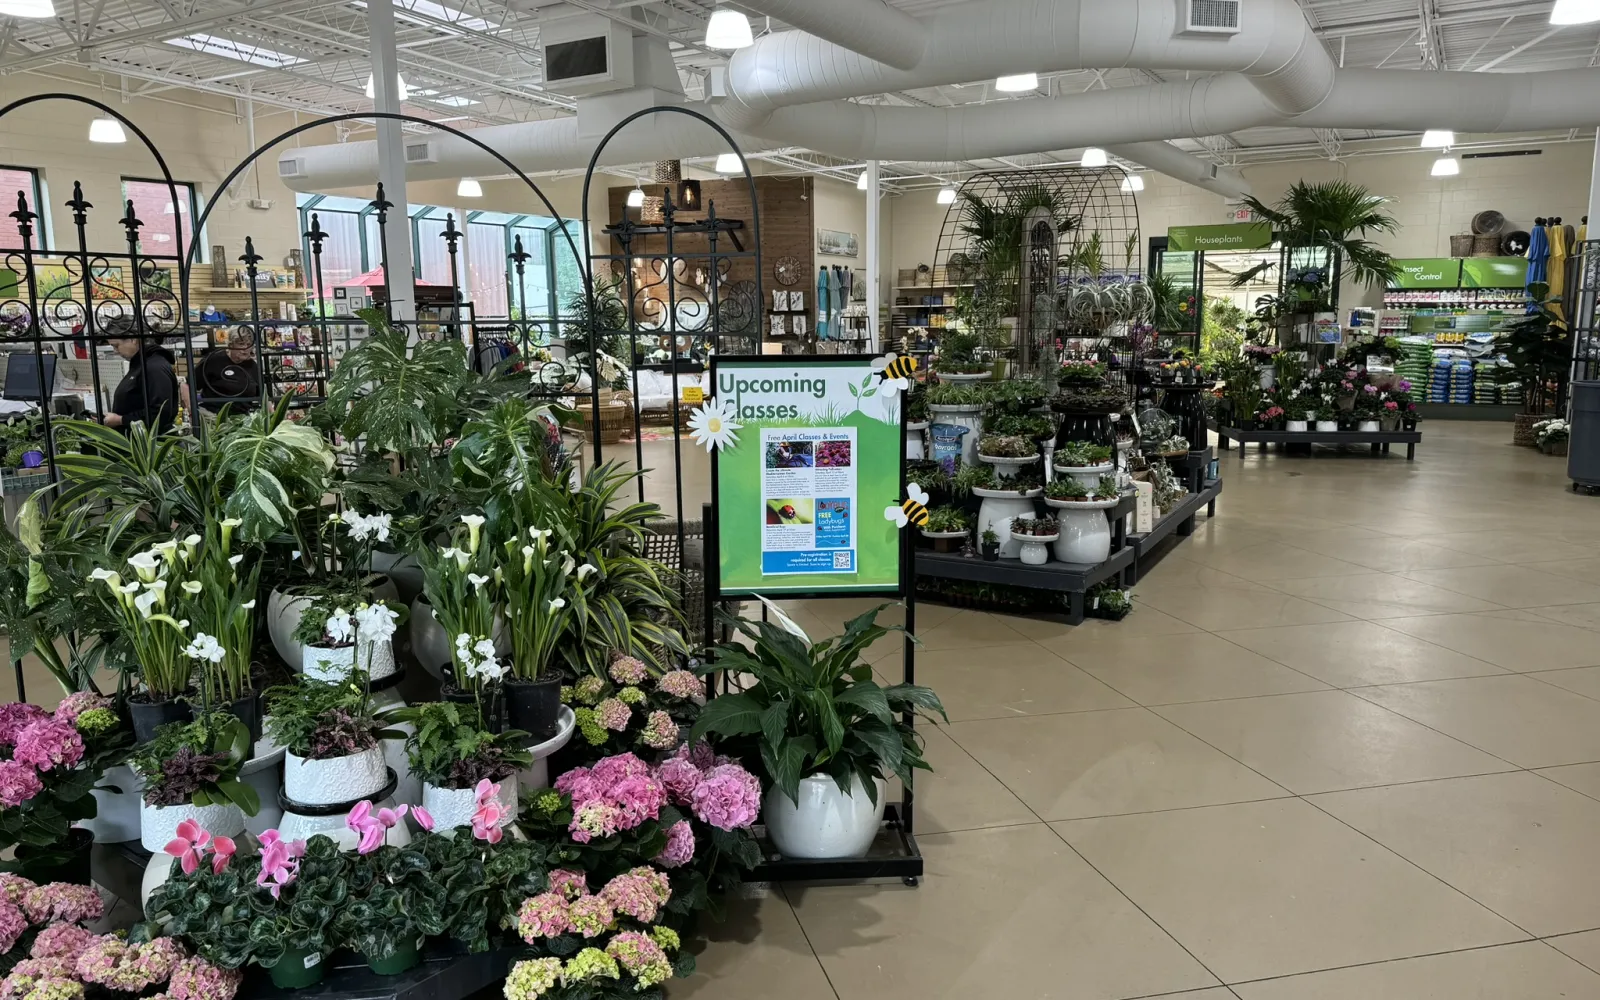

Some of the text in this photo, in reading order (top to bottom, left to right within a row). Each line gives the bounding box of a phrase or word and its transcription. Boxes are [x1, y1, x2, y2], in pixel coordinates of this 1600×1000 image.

[1236, 210, 1249, 218] EXIT
[1194, 234, 1243, 244] Houseplants
[1414, 272, 1442, 280] Control
[720, 372, 826, 398] Upcoming
[782, 434, 798, 442] April
[818, 518, 845, 526] Ladybugs
